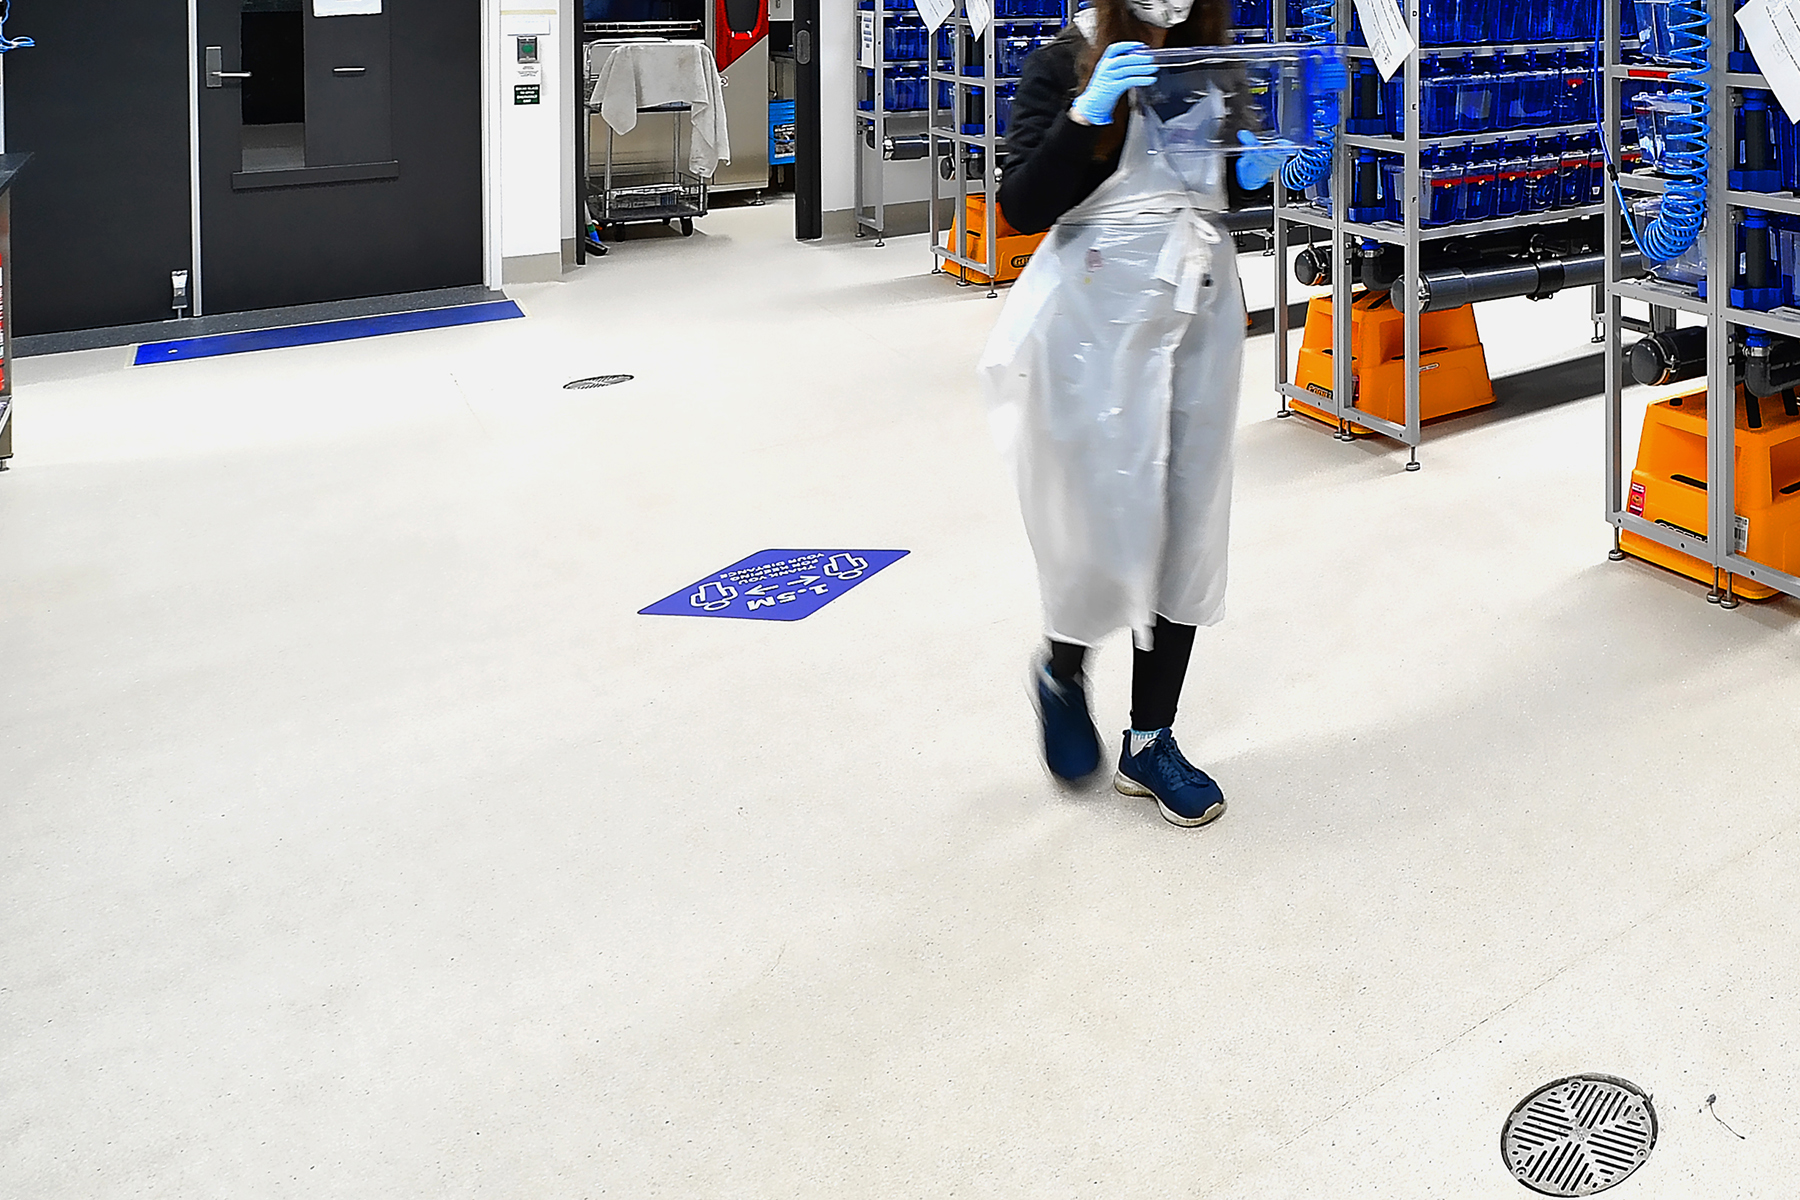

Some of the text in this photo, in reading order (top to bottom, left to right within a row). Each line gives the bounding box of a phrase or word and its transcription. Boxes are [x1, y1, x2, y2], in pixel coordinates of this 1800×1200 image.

[719, 553, 825, 579] YOUR DISTANCE
[729, 559, 819, 582] FOR KEEPING
[738, 565, 817, 585] THANK YOU
[746, 583, 829, 611] 1.5M
